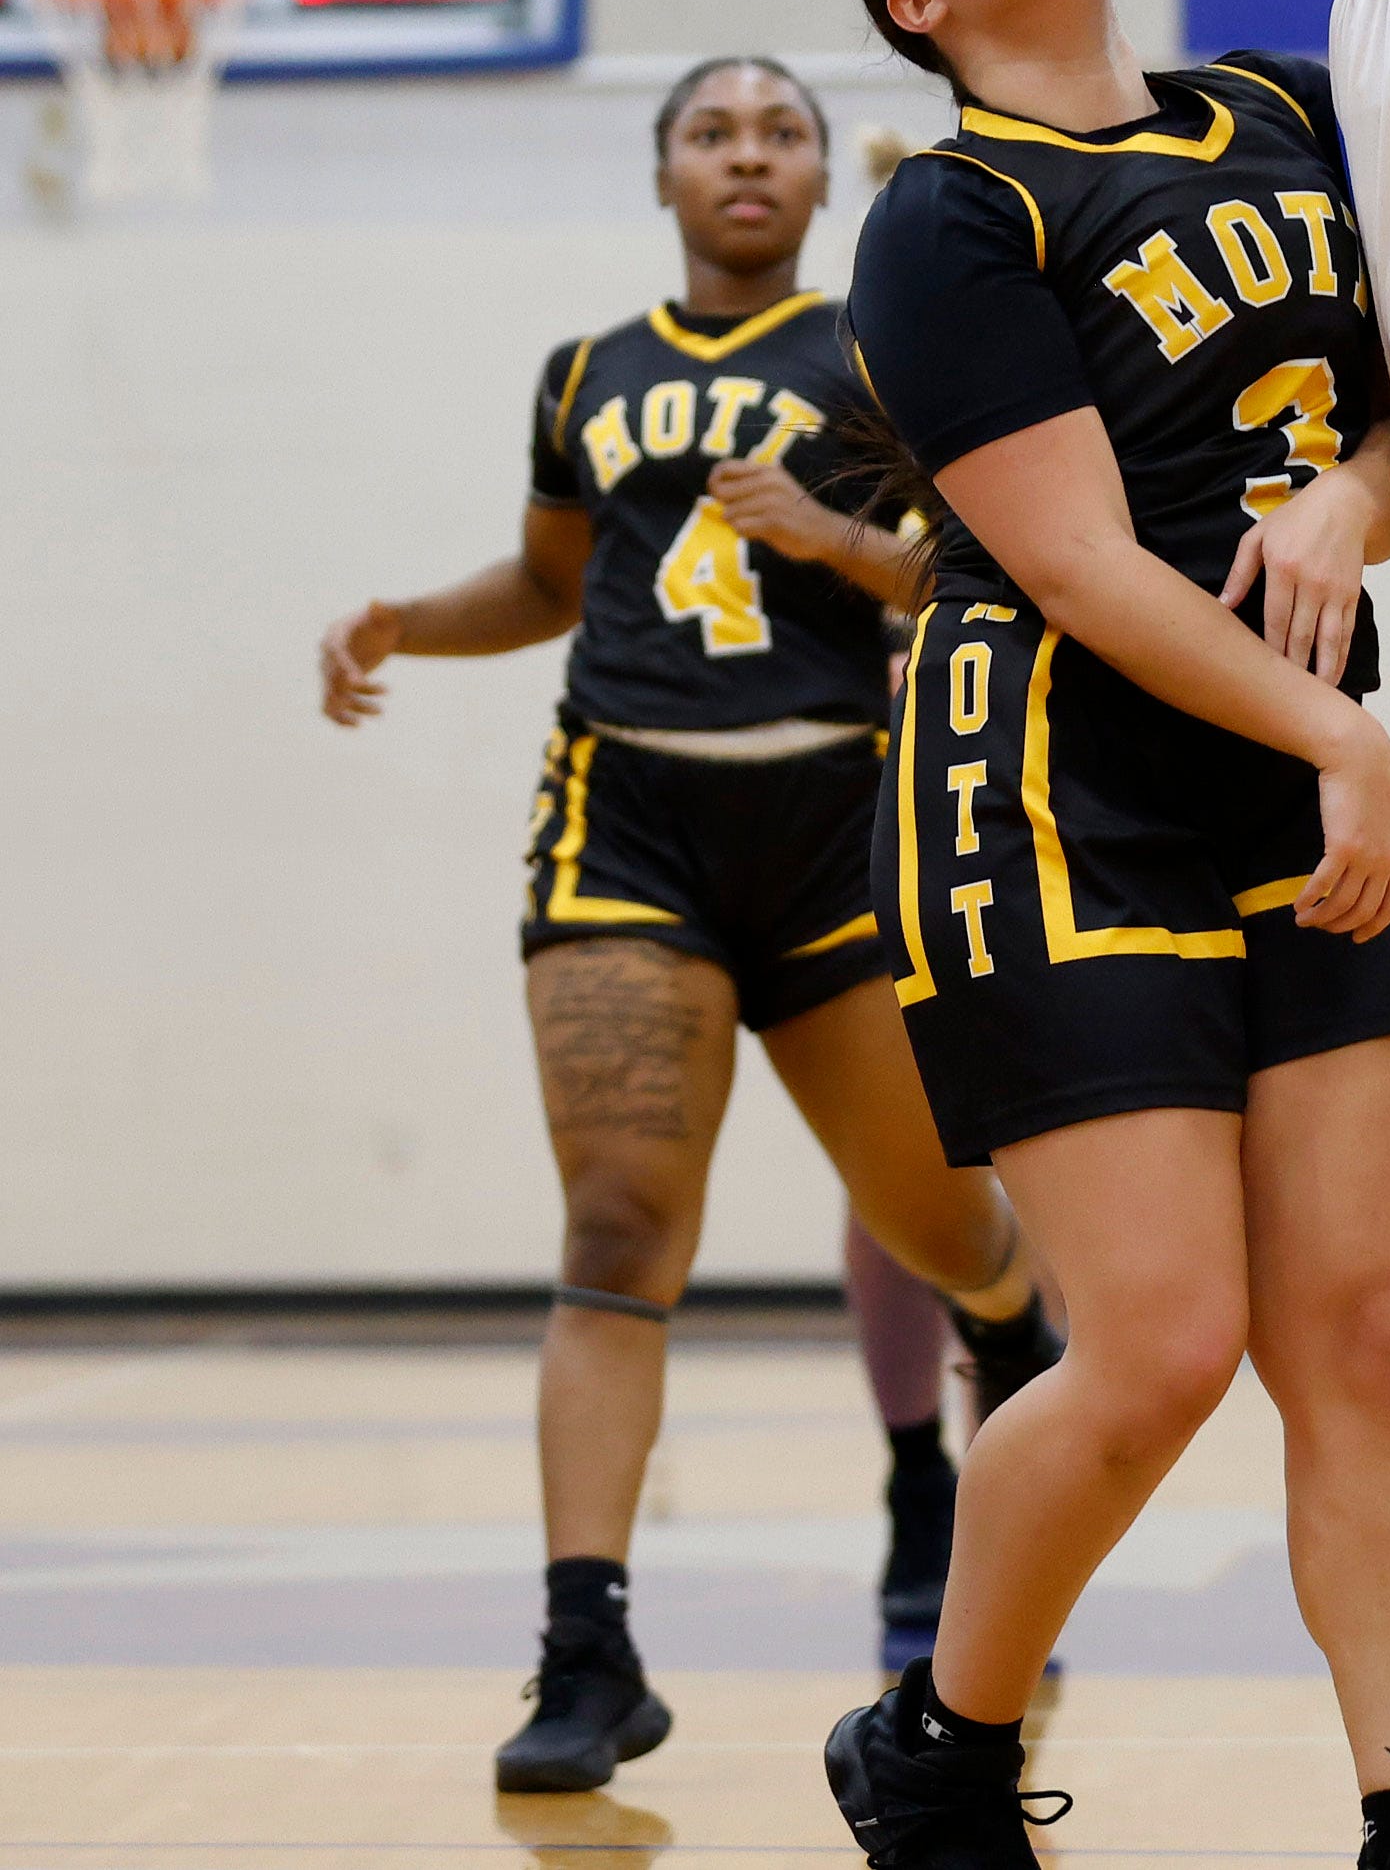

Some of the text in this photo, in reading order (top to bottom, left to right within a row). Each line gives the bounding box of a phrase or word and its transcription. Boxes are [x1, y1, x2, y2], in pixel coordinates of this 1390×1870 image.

[581, 376, 827, 495] MOTT
[1232, 356, 1344, 522] 3
[653, 494, 772, 660] 4
